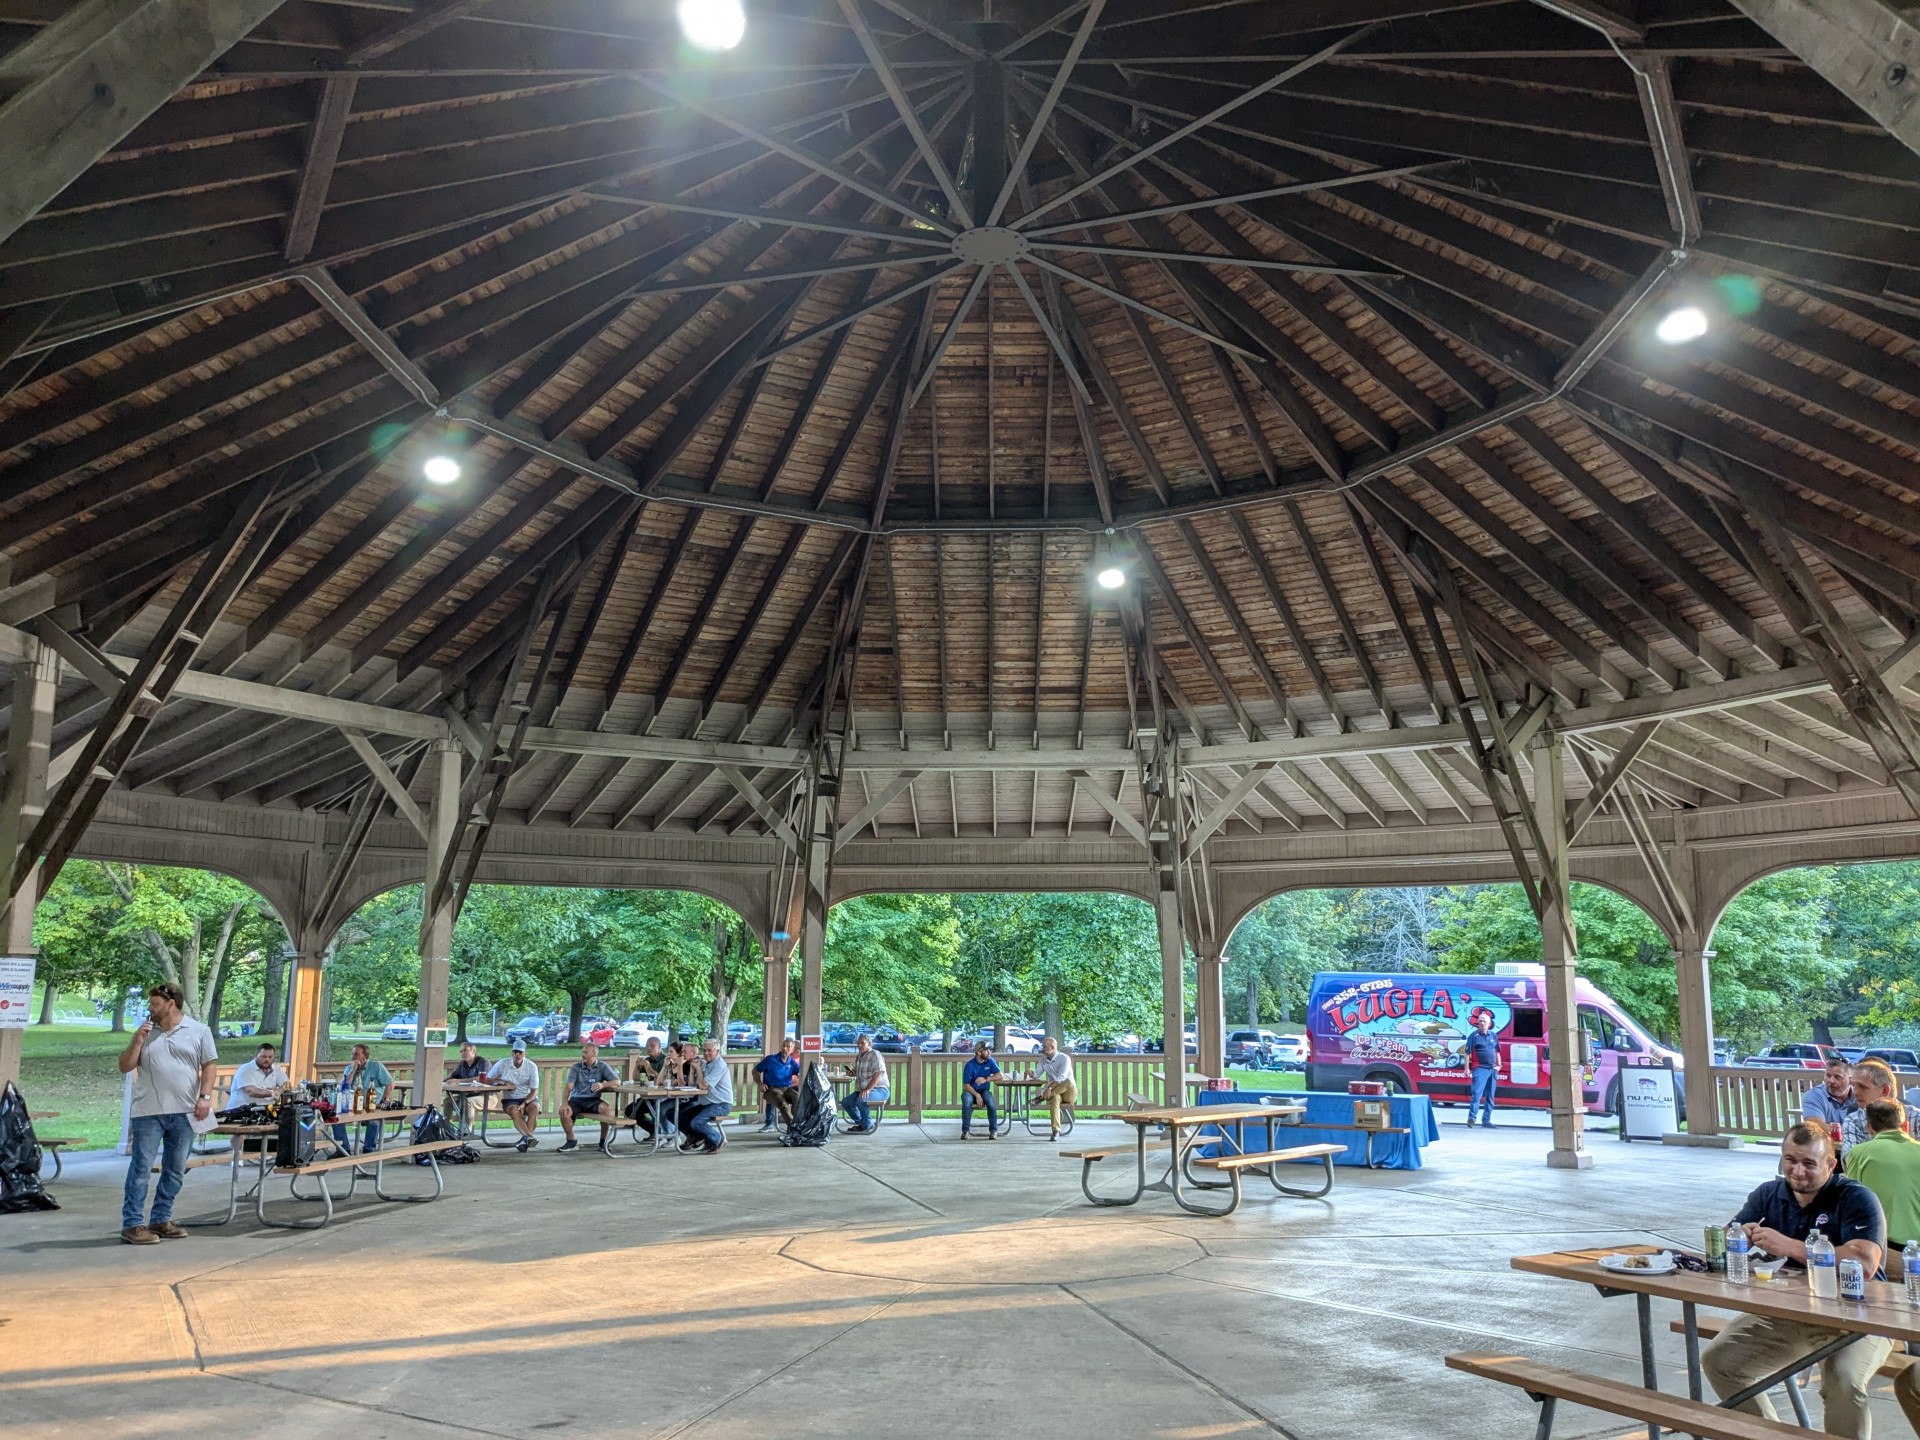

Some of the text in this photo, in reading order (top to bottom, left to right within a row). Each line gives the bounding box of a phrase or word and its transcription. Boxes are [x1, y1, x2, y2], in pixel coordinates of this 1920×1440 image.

[1353, 1034, 1407, 1053] Ice Cream
[1841, 1282, 1861, 1290] LIGHT
